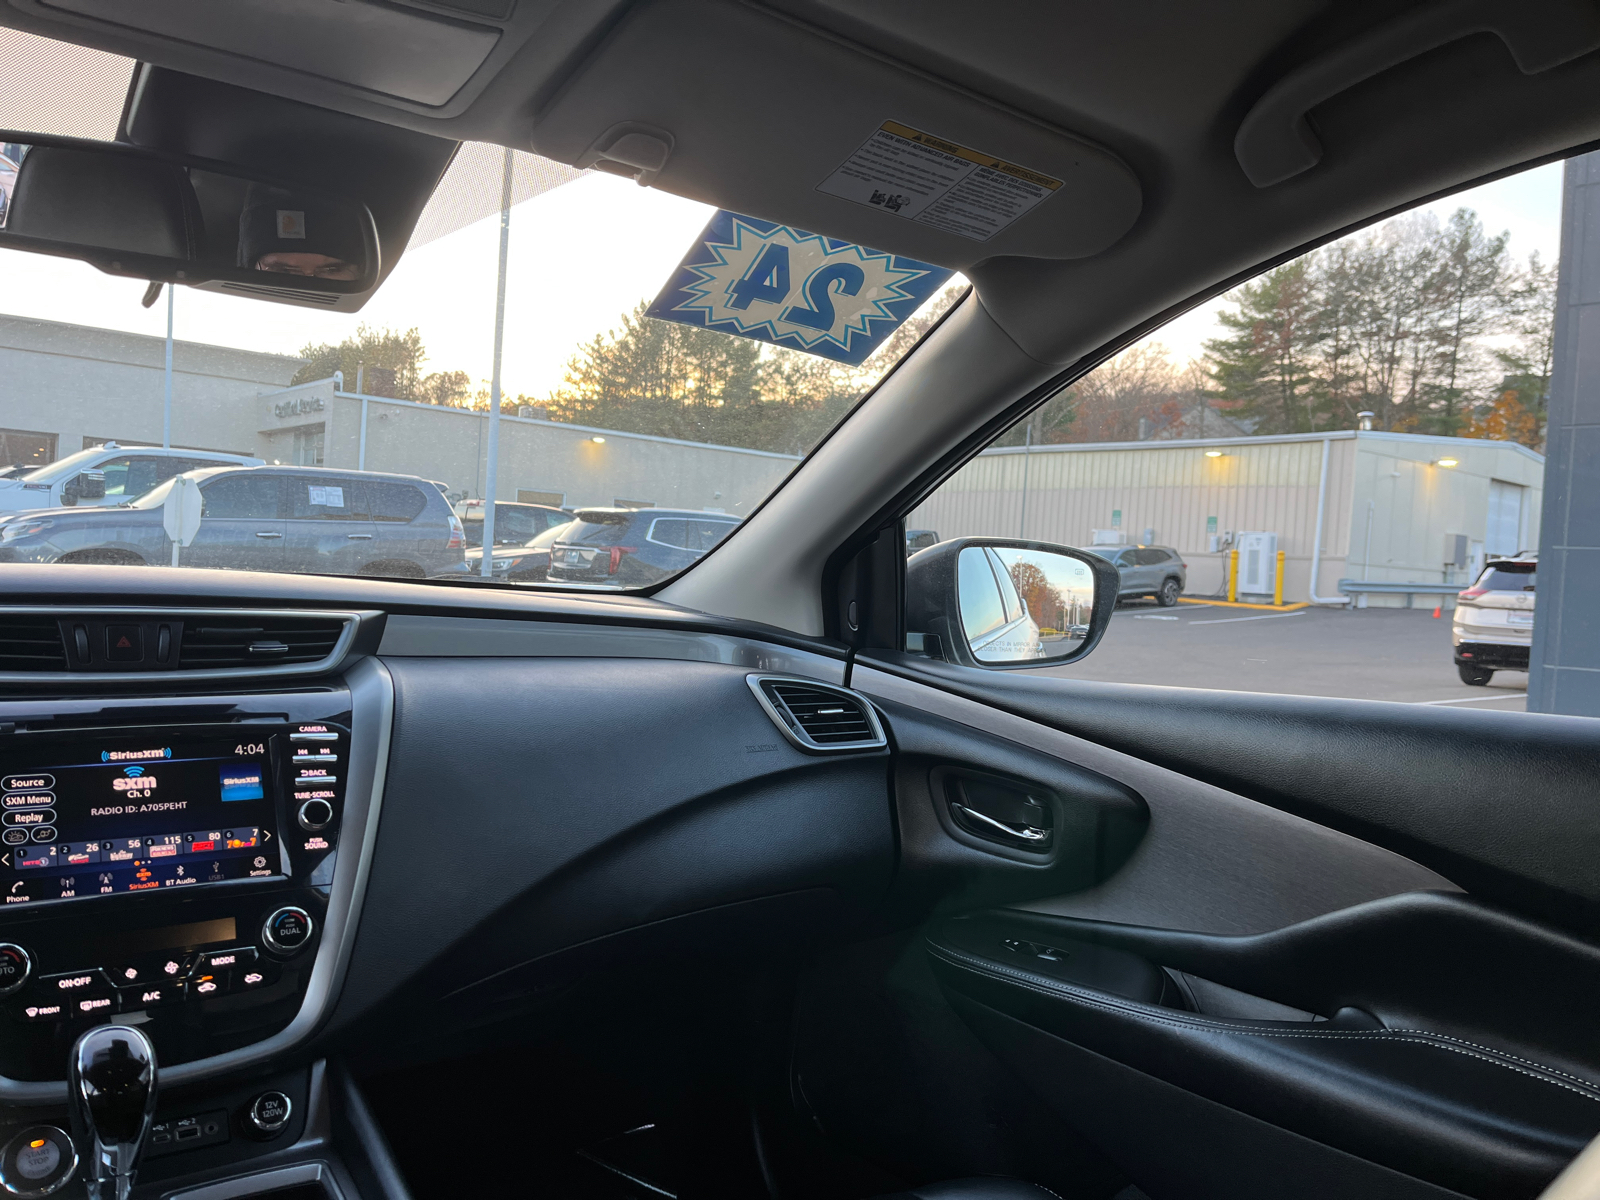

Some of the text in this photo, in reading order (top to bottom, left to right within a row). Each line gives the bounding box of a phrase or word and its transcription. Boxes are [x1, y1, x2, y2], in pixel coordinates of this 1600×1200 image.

[877, 132, 895, 141] EVEN
[895, 137, 912, 147] WITH
[911, 142, 944, 158] ADVANCED
[953, 158, 971, 168] BAGS
[234, 743, 265, 756] 4:04
[11, 779, 45, 788] Source
[127, 789, 151, 798] Ch. 0
[6, 795, 51, 806] SXM Menu
[91, 801, 188, 816] RADIO ID: A705PEHT
[15, 813, 44, 823] Replay
[208, 832, 221, 840] 80
[252, 828, 258, 836] 7
[128, 839, 141, 849] 56
[164, 836, 182, 845] 115
[86, 843, 99, 853] 26
[304, 841, 329, 850] SOUND
[49, 846, 57, 856] 2
[249, 869, 272, 877] Settings
[129, 881, 159, 890] SiriusXM
[175, 877, 197, 885] Audio
[61, 890, 75, 898] AM
[101, 886, 113, 894] FM
[6, 894, 30, 903] Phone
[280, 927, 301, 936] DUAL
[211, 955, 236, 966] MODE
[0, 966, 15, 975] UTO
[142, 990, 161, 1002] A/C
[92, 998, 111, 1008] REAR
[39, 1006, 61, 1015] FRONT
[265, 1100, 279, 1109] 12V
[262, 1107, 284, 1118] 120W
